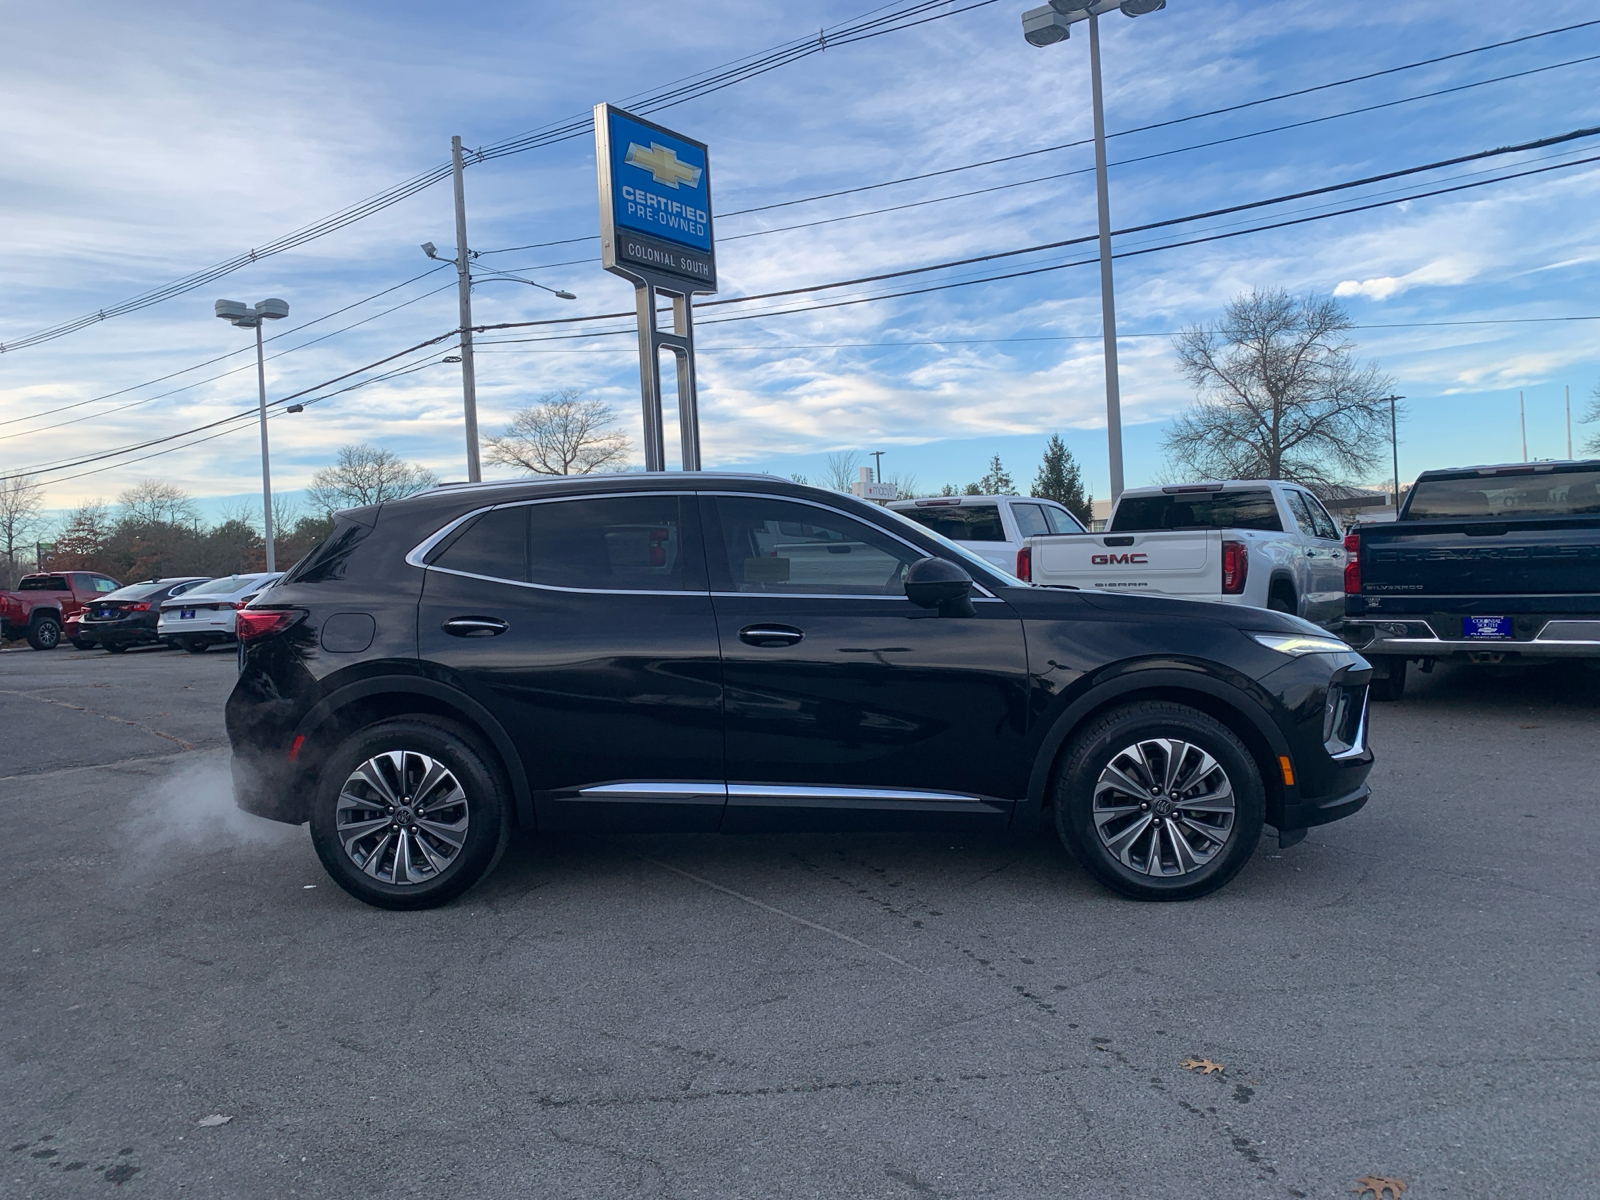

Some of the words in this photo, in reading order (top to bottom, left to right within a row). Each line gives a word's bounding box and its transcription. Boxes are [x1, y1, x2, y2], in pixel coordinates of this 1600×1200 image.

[622, 186, 707, 224] CERTIFIED
[628, 202, 704, 236] PRE-OWNED
[628, 243, 675, 266] COLONIAL
[681, 257, 709, 275] SOUTH
[1091, 553, 1149, 565] GMC
